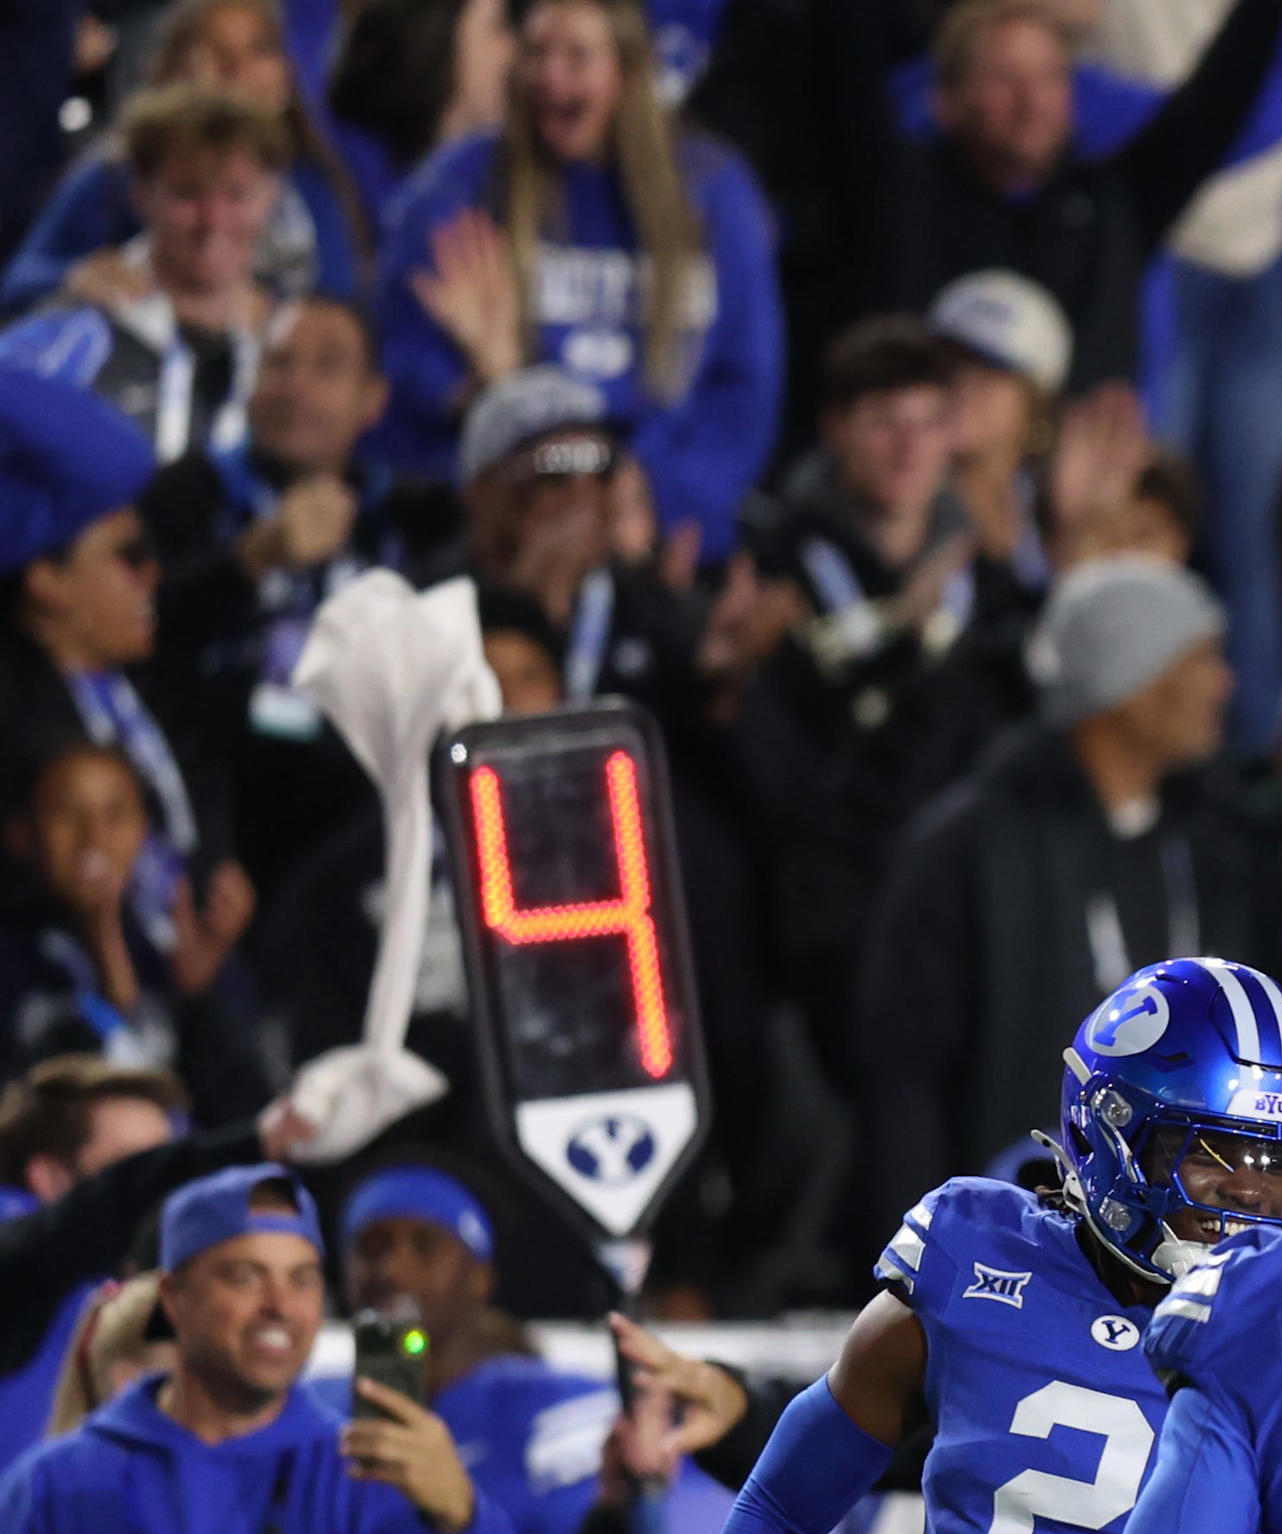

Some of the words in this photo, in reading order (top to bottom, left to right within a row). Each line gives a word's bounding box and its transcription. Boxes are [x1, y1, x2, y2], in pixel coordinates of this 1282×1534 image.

[469, 750, 675, 1079] 4
[1095, 989, 1158, 1047] Y
[577, 1116, 647, 1185] Y
[966, 1267, 1028, 1306] XII
[1101, 1319, 1131, 1345] Y
